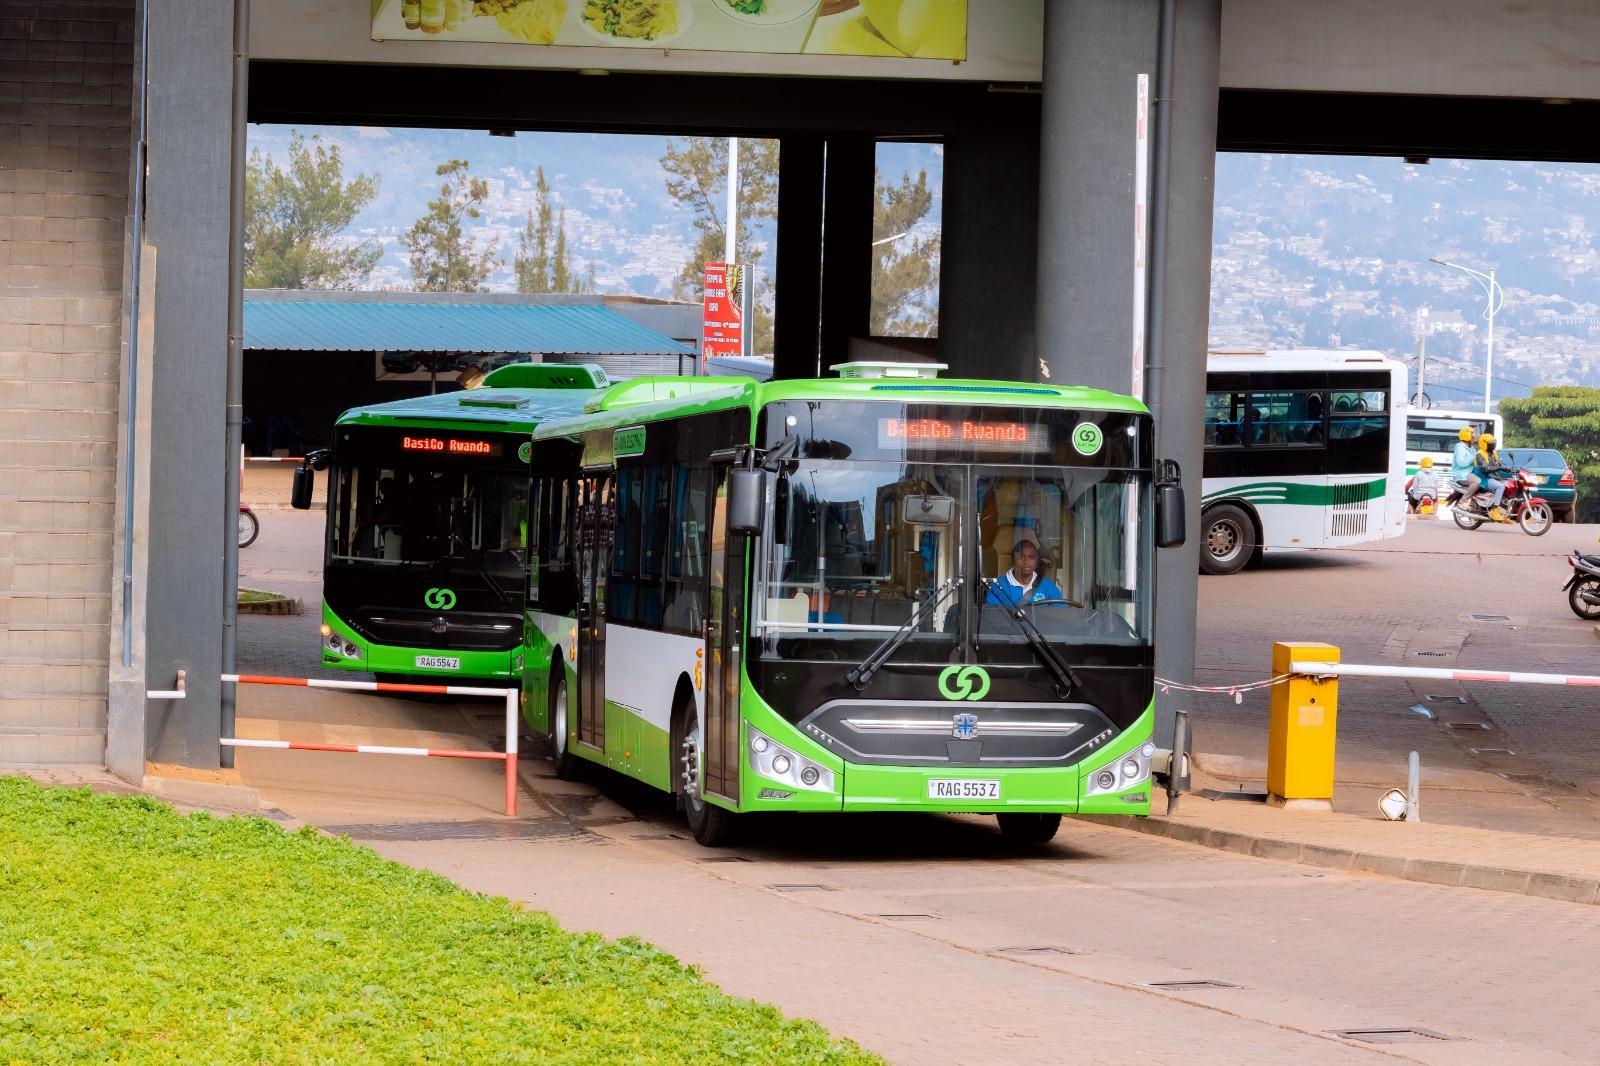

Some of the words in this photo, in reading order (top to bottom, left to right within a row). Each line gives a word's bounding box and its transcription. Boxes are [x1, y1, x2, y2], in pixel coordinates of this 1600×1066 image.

[887, 419, 951, 438] BasiGo
[963, 422, 1026, 441] Rwanda
[403, 437, 444, 450] BasiGo
[450, 440, 490, 453] Rwanda
[421, 657, 436, 667] RAG
[436, 658, 451, 668] 554
[452, 659, 458, 668] Z
[937, 782, 961, 796] RAG
[963, 783, 986, 796] 553
[988, 783, 997, 797] Z
